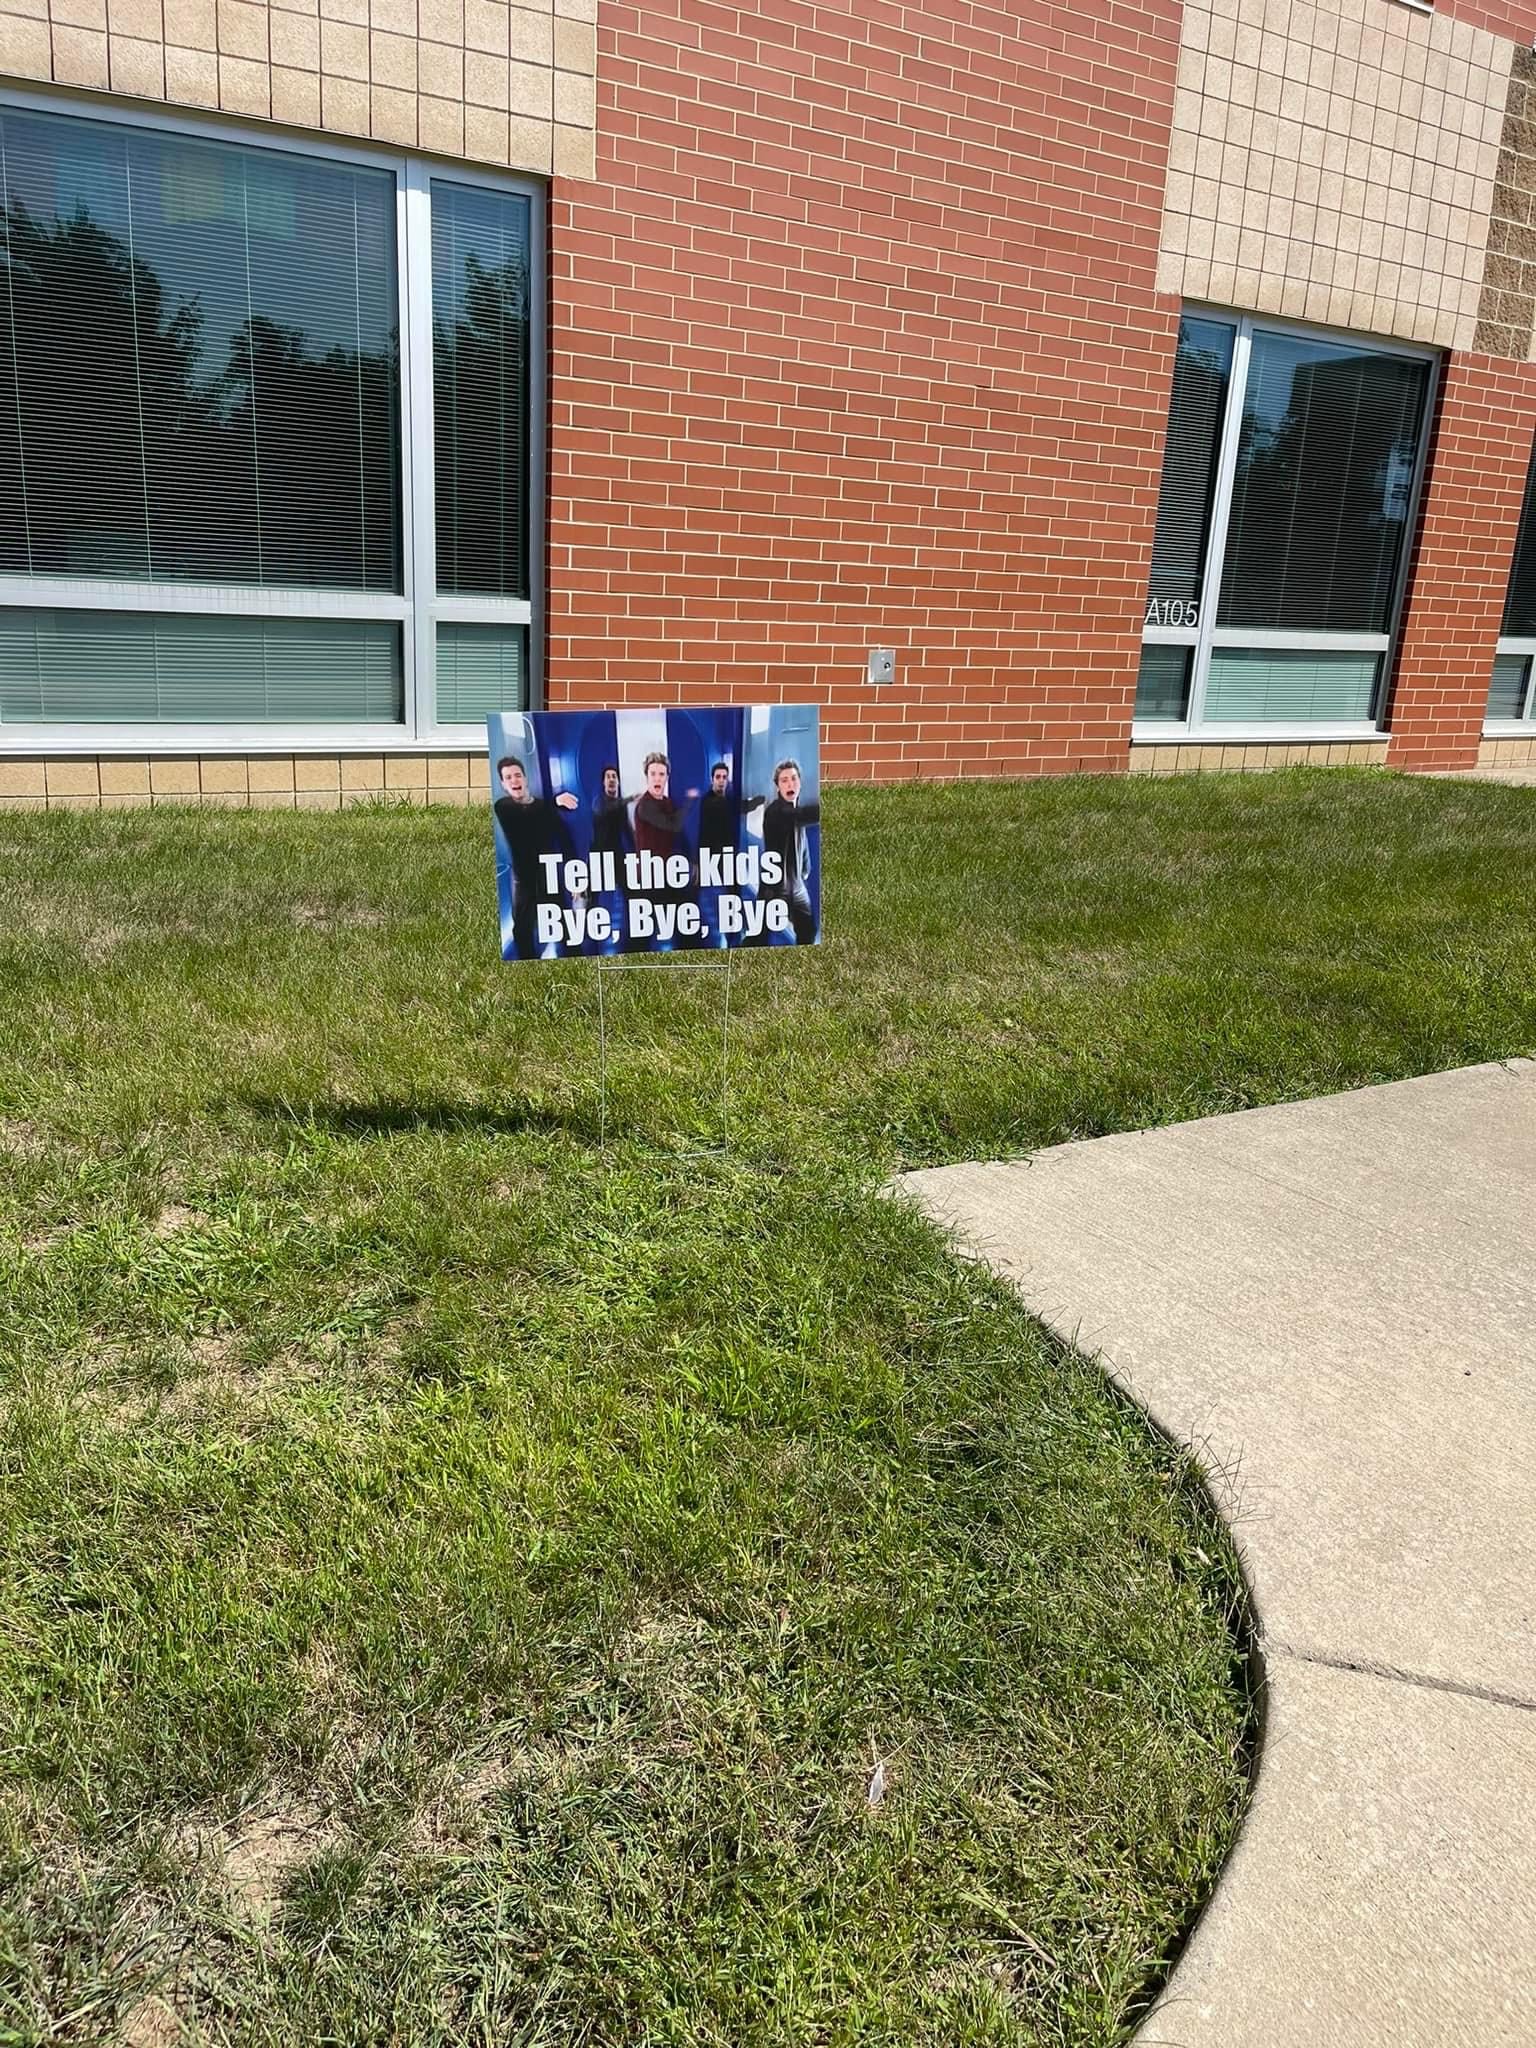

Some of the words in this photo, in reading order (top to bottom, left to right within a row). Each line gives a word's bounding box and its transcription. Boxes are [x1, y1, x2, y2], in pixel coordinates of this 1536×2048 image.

[1144, 598, 1199, 627] A105
[539, 851, 616, 894] Tell
[624, 849, 690, 889] the
[699, 845, 783, 887] kids
[537, 903, 620, 946] Bye,
[628, 898, 709, 940] Bye,
[718, 894, 789, 936] Bye
